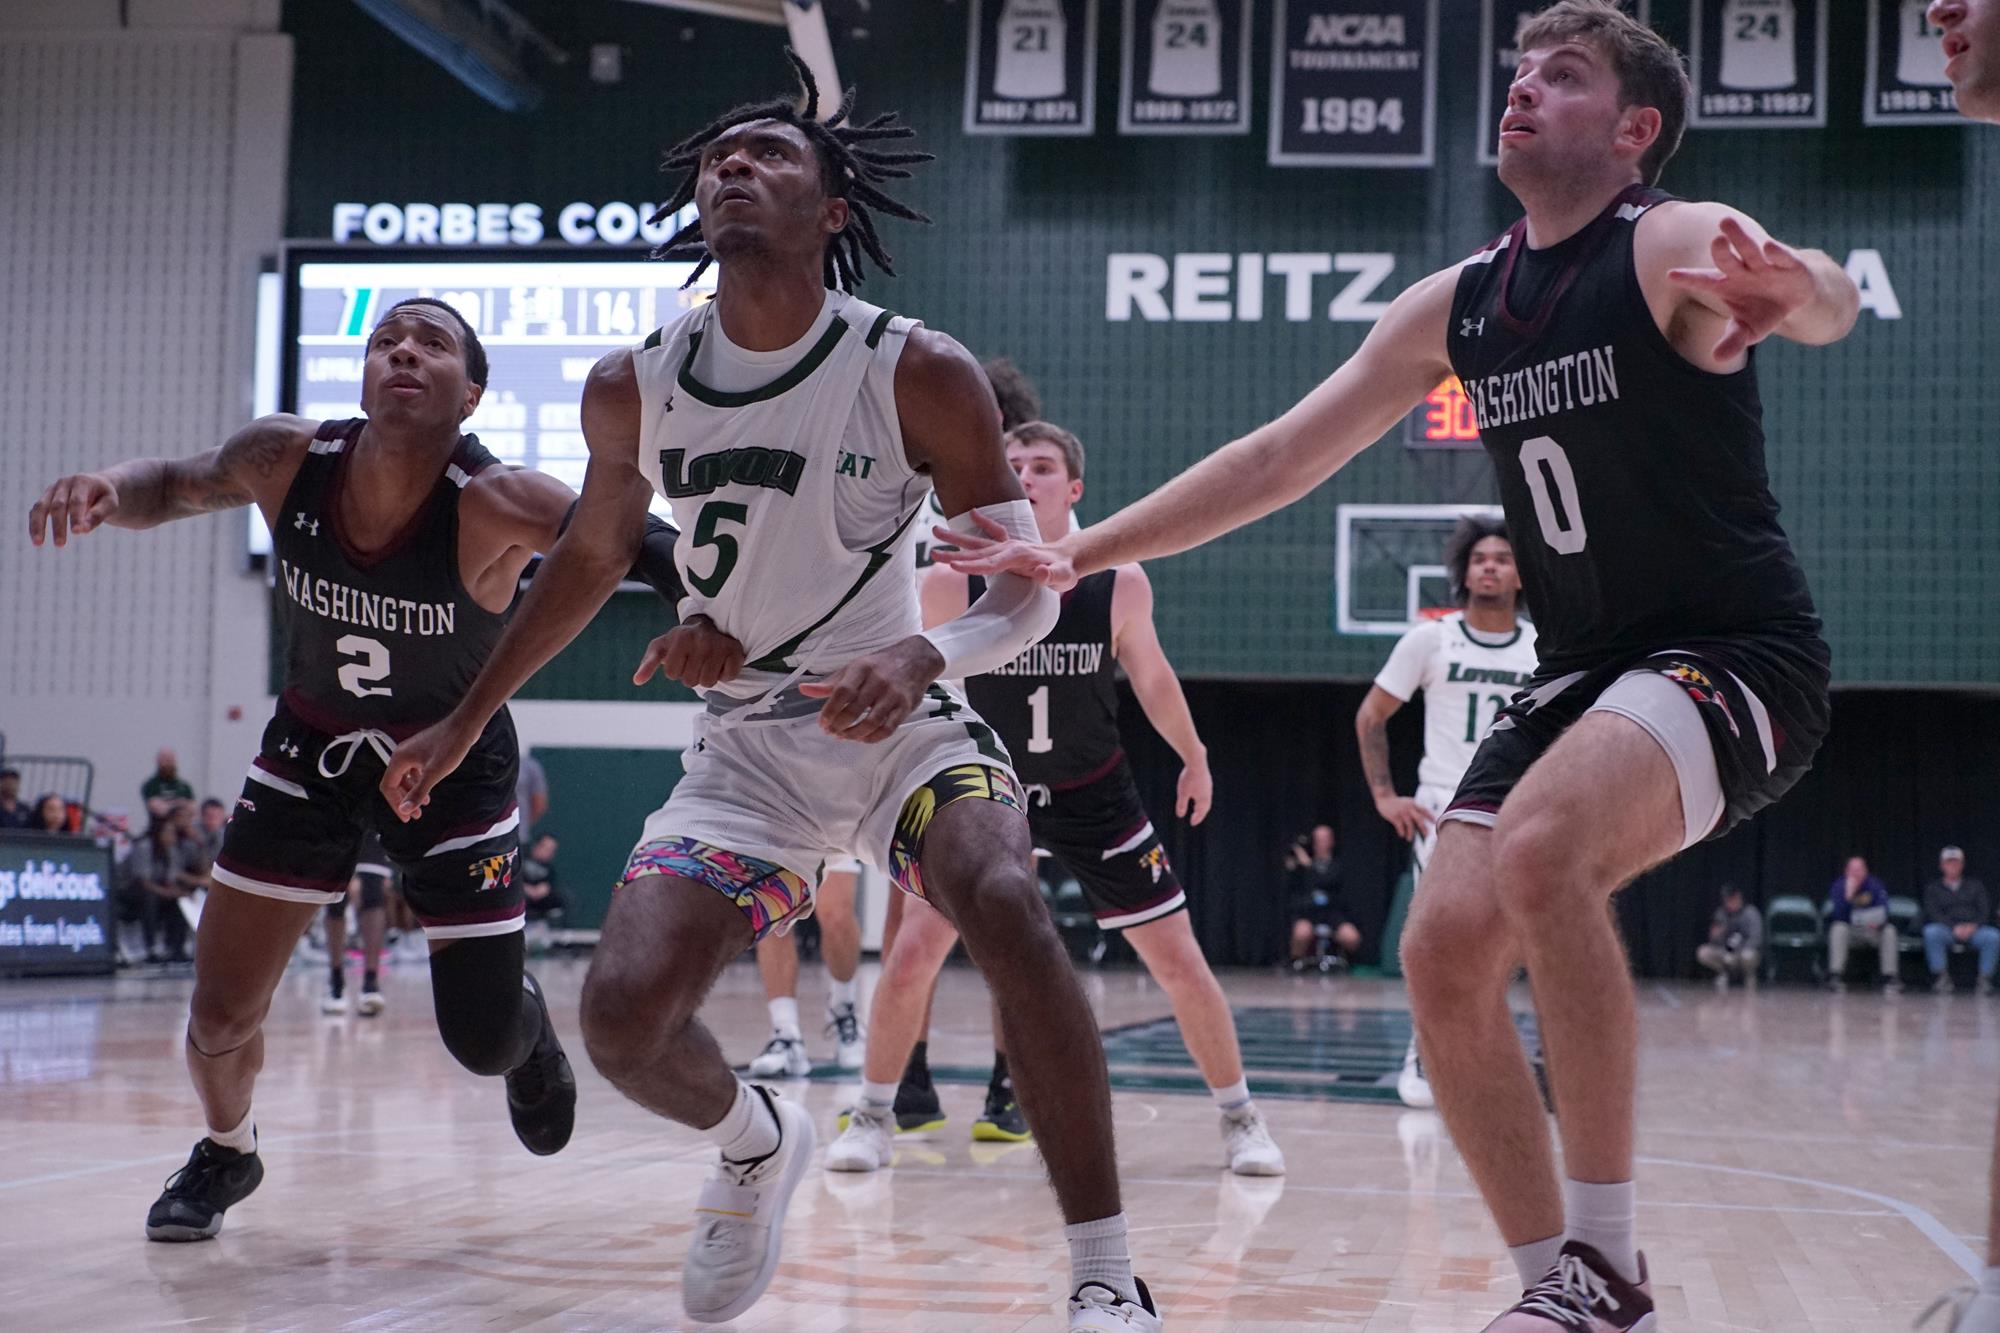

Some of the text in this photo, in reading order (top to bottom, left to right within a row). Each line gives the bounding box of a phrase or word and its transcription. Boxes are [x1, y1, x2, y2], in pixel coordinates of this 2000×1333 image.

[1013, 26, 1049, 52] 21
[1165, 22, 1208, 49] 24
[1304, 14, 1406, 45] NCAA
[1735, 13, 1780, 40] 24
[1290, 51, 1420, 70] TOURNAMENT
[1300, 97, 1405, 134] 1994
[332, 202, 545, 245] FORBES
[1105, 253, 1396, 322] REITZ
[593, 290, 636, 335] 14
[1425, 393, 1480, 440] 30
[1518, 435, 1588, 555] 0
[686, 500, 749, 599] 5
[281, 559, 456, 636] WASHINGTON
[336, 633, 393, 698] 2
[1027, 685, 1054, 754] 1
[19, 859, 105, 900] delicious.
